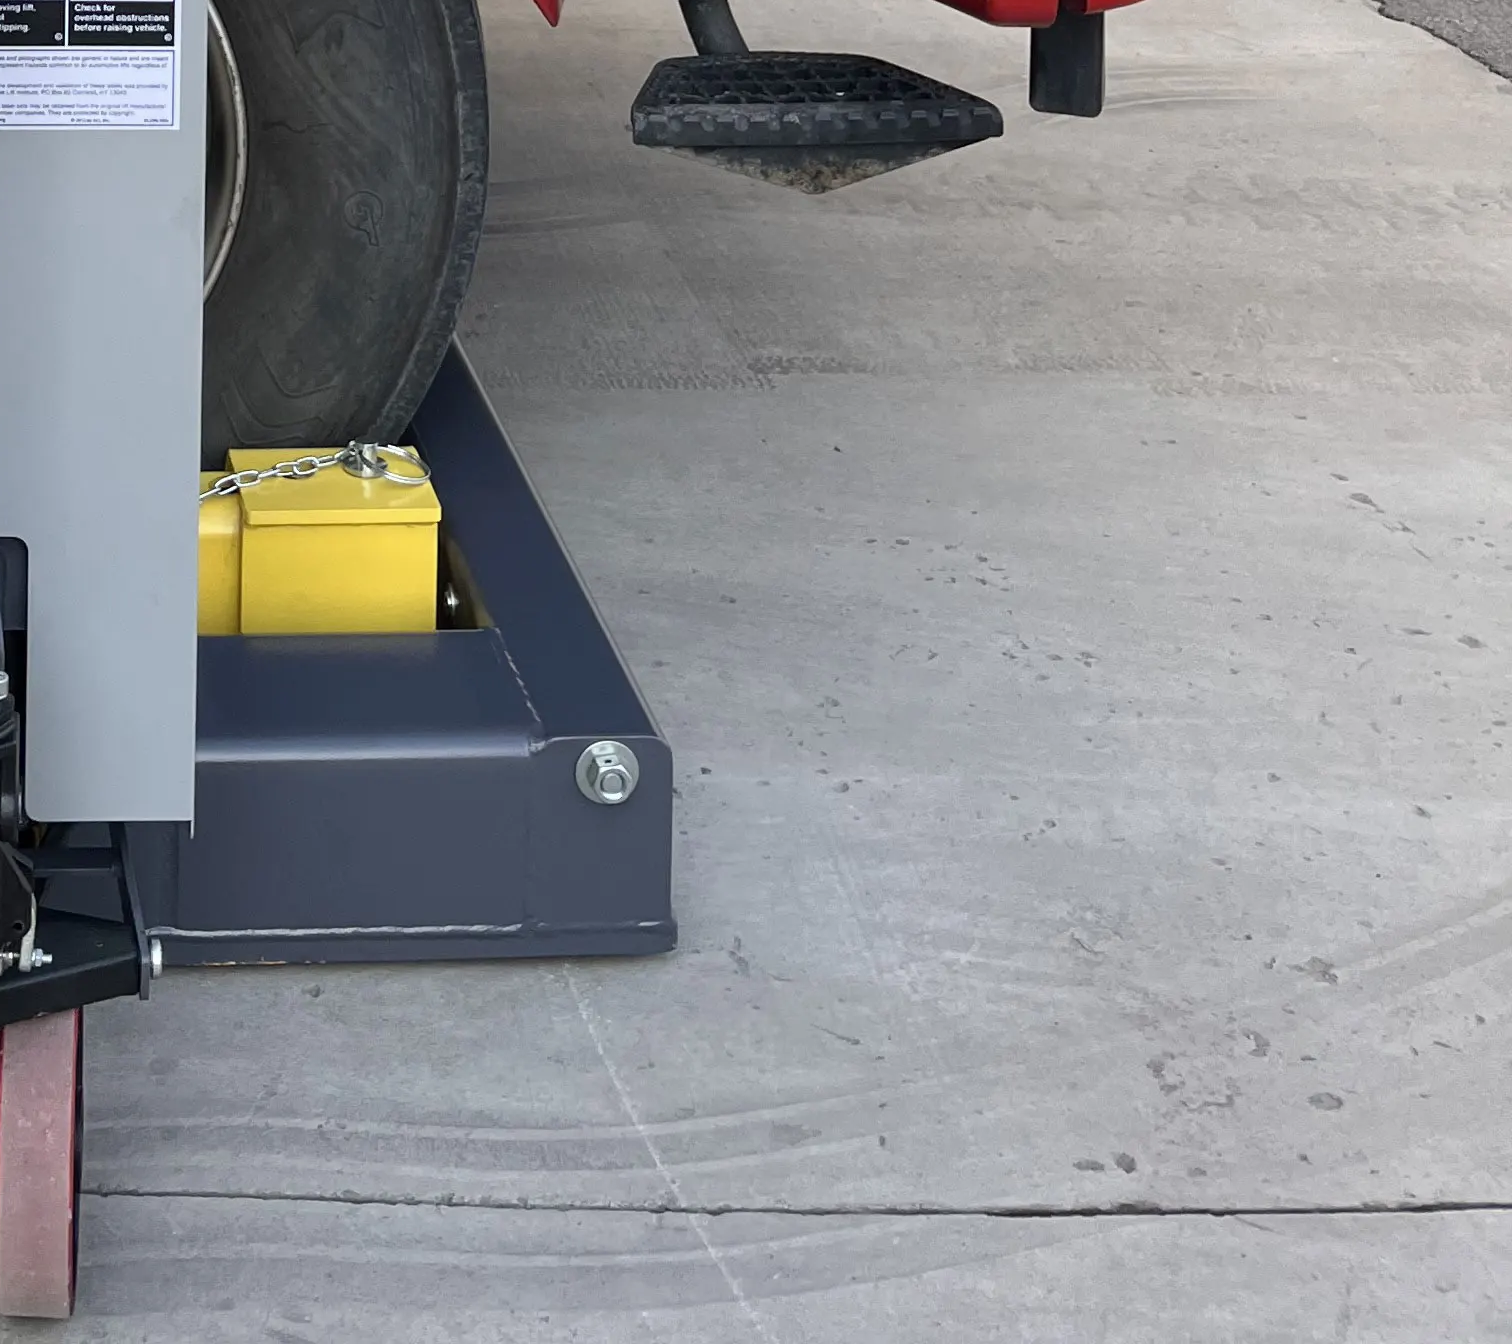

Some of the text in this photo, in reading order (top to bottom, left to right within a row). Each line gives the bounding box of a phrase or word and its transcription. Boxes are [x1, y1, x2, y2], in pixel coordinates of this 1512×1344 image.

[74, 4, 116, 12] Check for
[74, 13, 170, 21] overhead obstructions
[74, 23, 167, 34] before raising vehicle.
